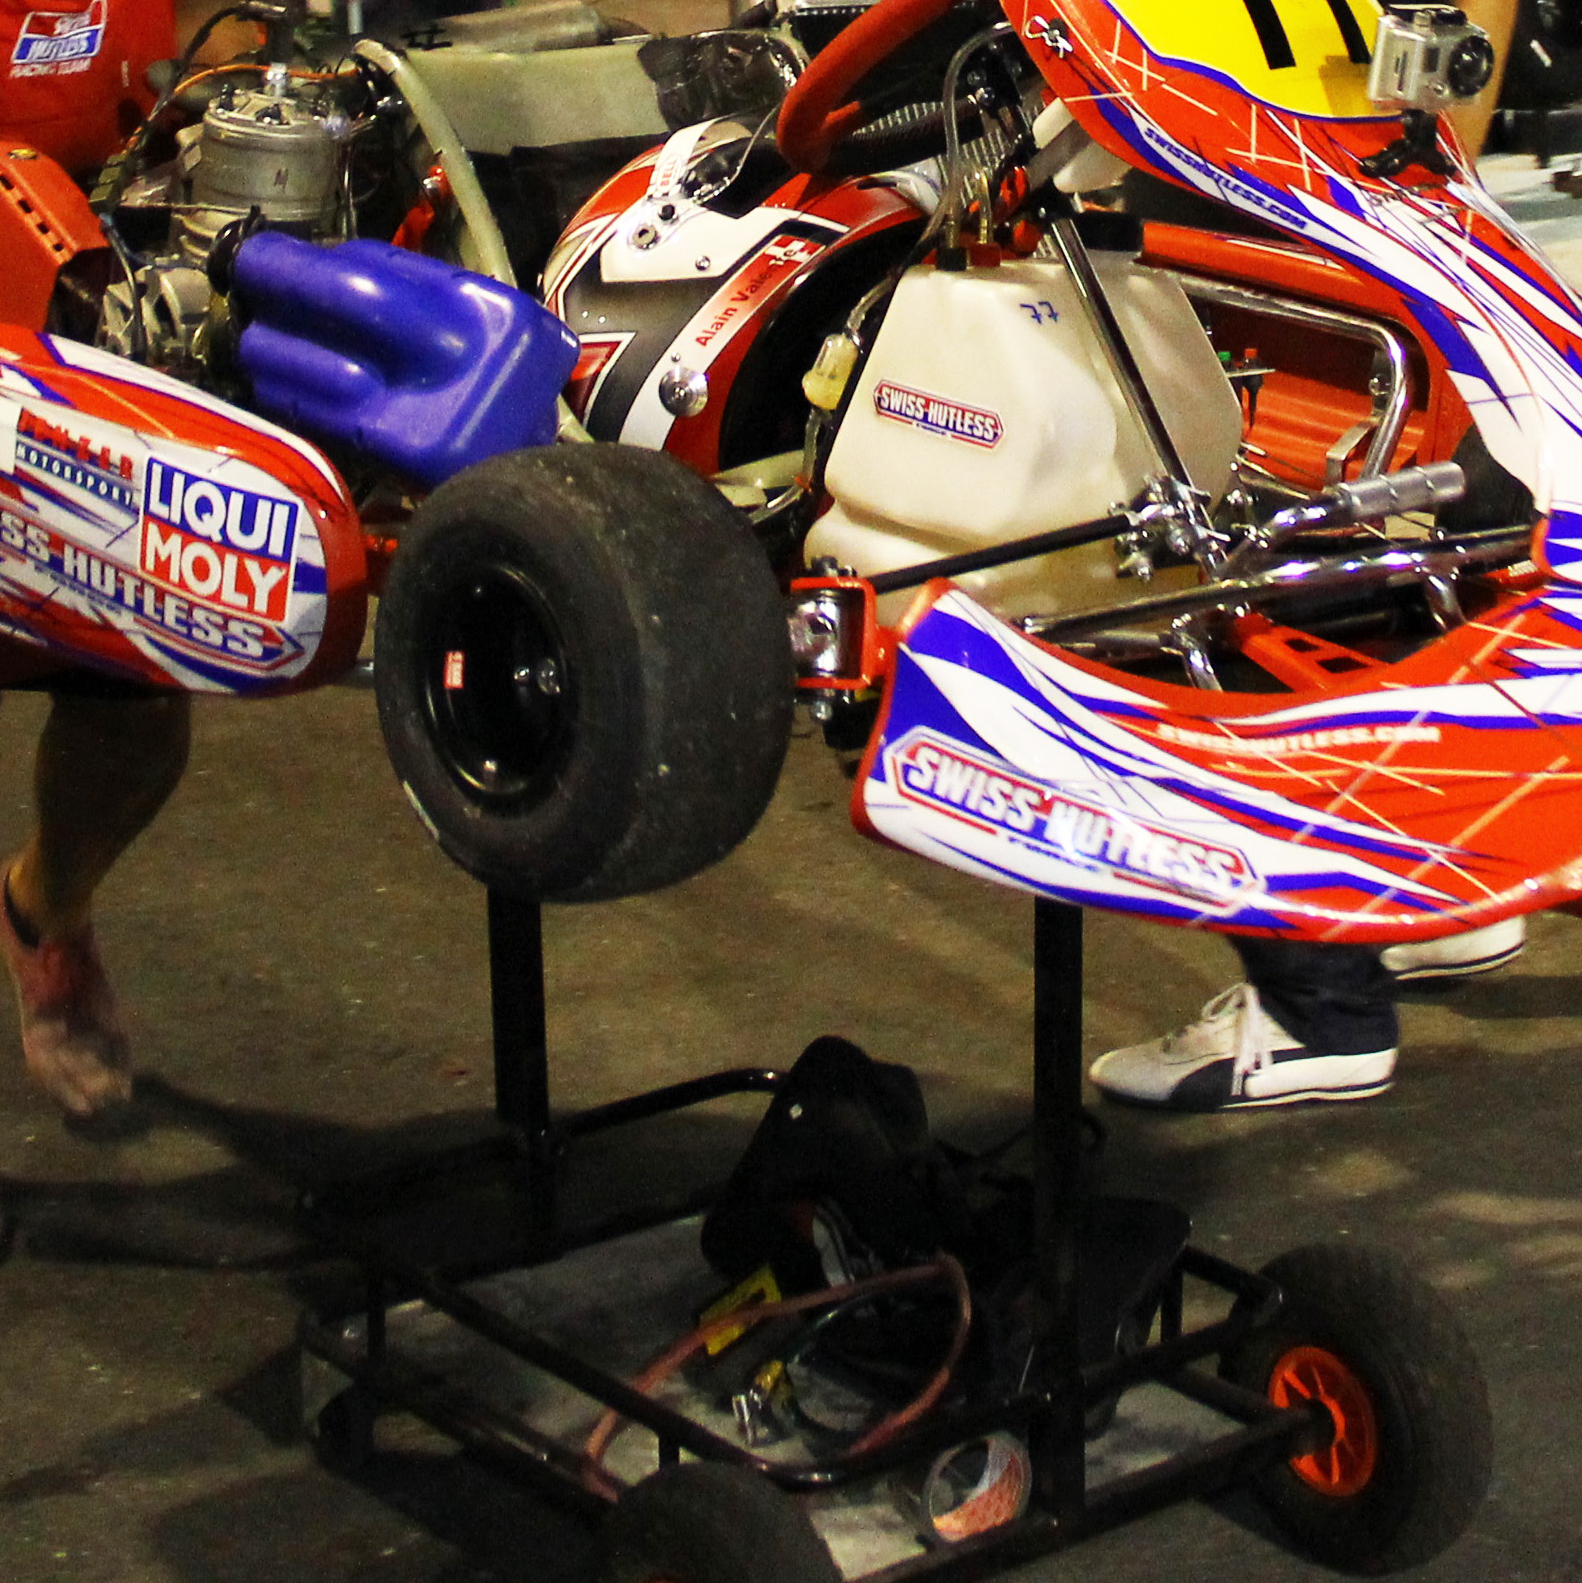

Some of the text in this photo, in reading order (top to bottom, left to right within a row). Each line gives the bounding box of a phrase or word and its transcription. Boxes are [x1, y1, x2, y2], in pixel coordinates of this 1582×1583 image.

[695, 306, 738, 347] Alain
[16, 443, 134, 506] MOTORSPORT
[148, 464, 287, 557] LIQUI
[145, 521, 286, 614] MOLY
